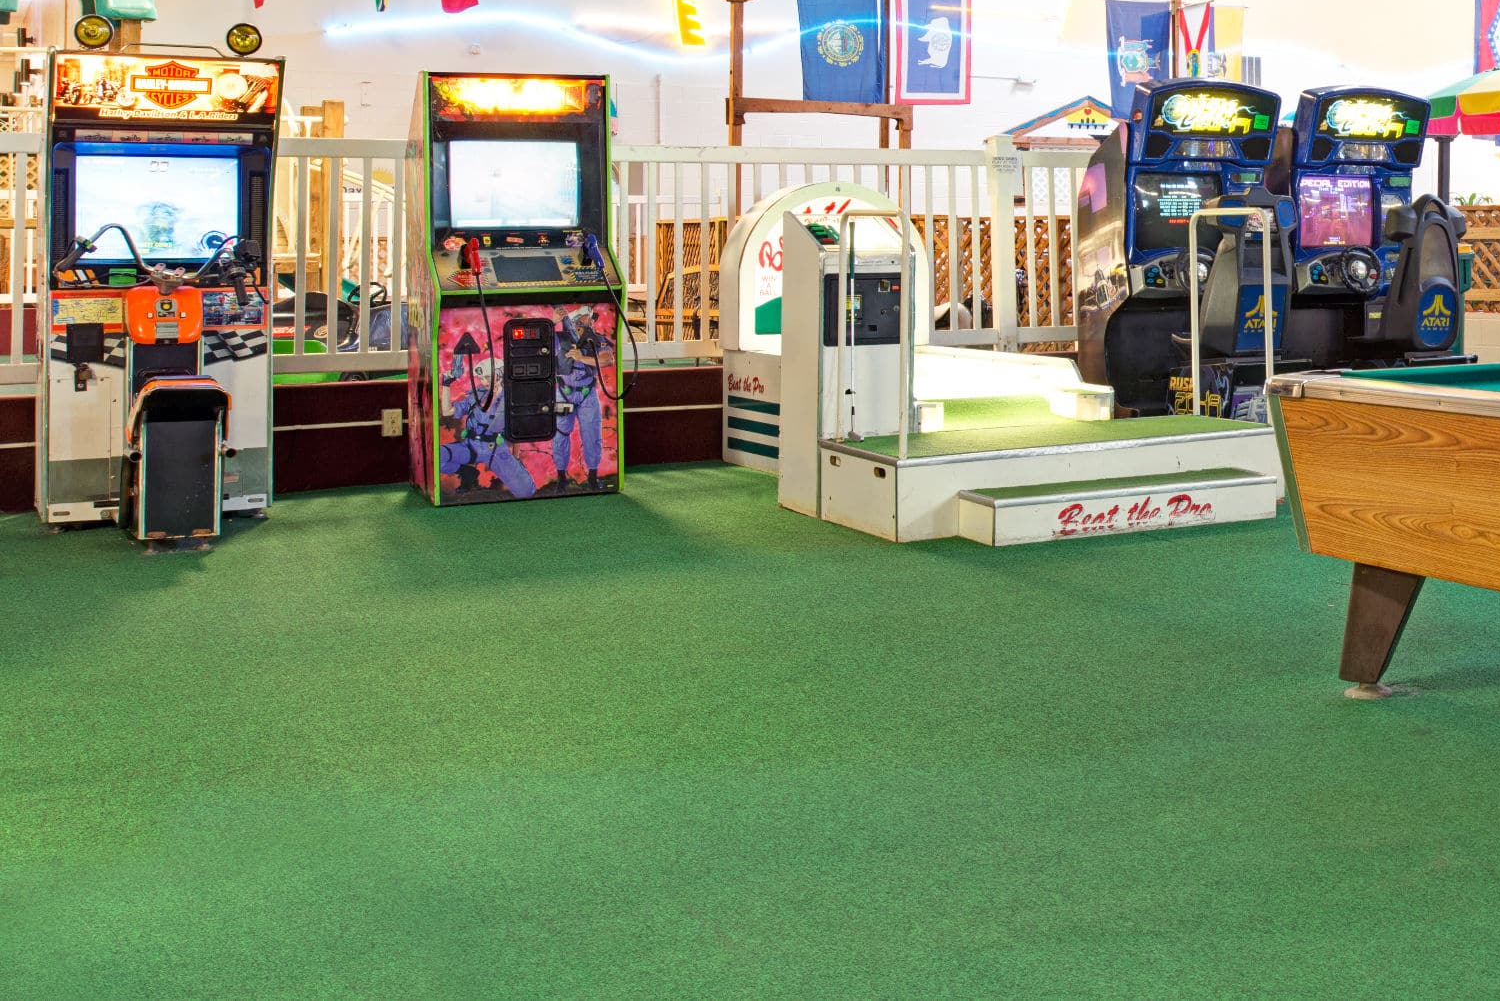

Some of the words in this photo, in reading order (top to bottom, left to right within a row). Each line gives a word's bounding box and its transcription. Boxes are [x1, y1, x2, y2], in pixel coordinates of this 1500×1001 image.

[152, 66, 193, 78] MOTOR
[151, 92, 191, 105] CYCLES
[1300, 179, 1333, 188] PECIAL
[1337, 180, 1370, 189] EDITION
[1244, 318, 1277, 329] ATAI
[1421, 317, 1450, 327] ATARI
[727, 373, 742, 392] Beat
[743, 375, 752, 392] the
[752, 376, 765, 396] Pro
[1169, 376, 1193, 392] RUS
[1057, 503, 1119, 536] Beat
[1127, 496, 1161, 527] the
[1166, 493, 1214, 526] Pro
